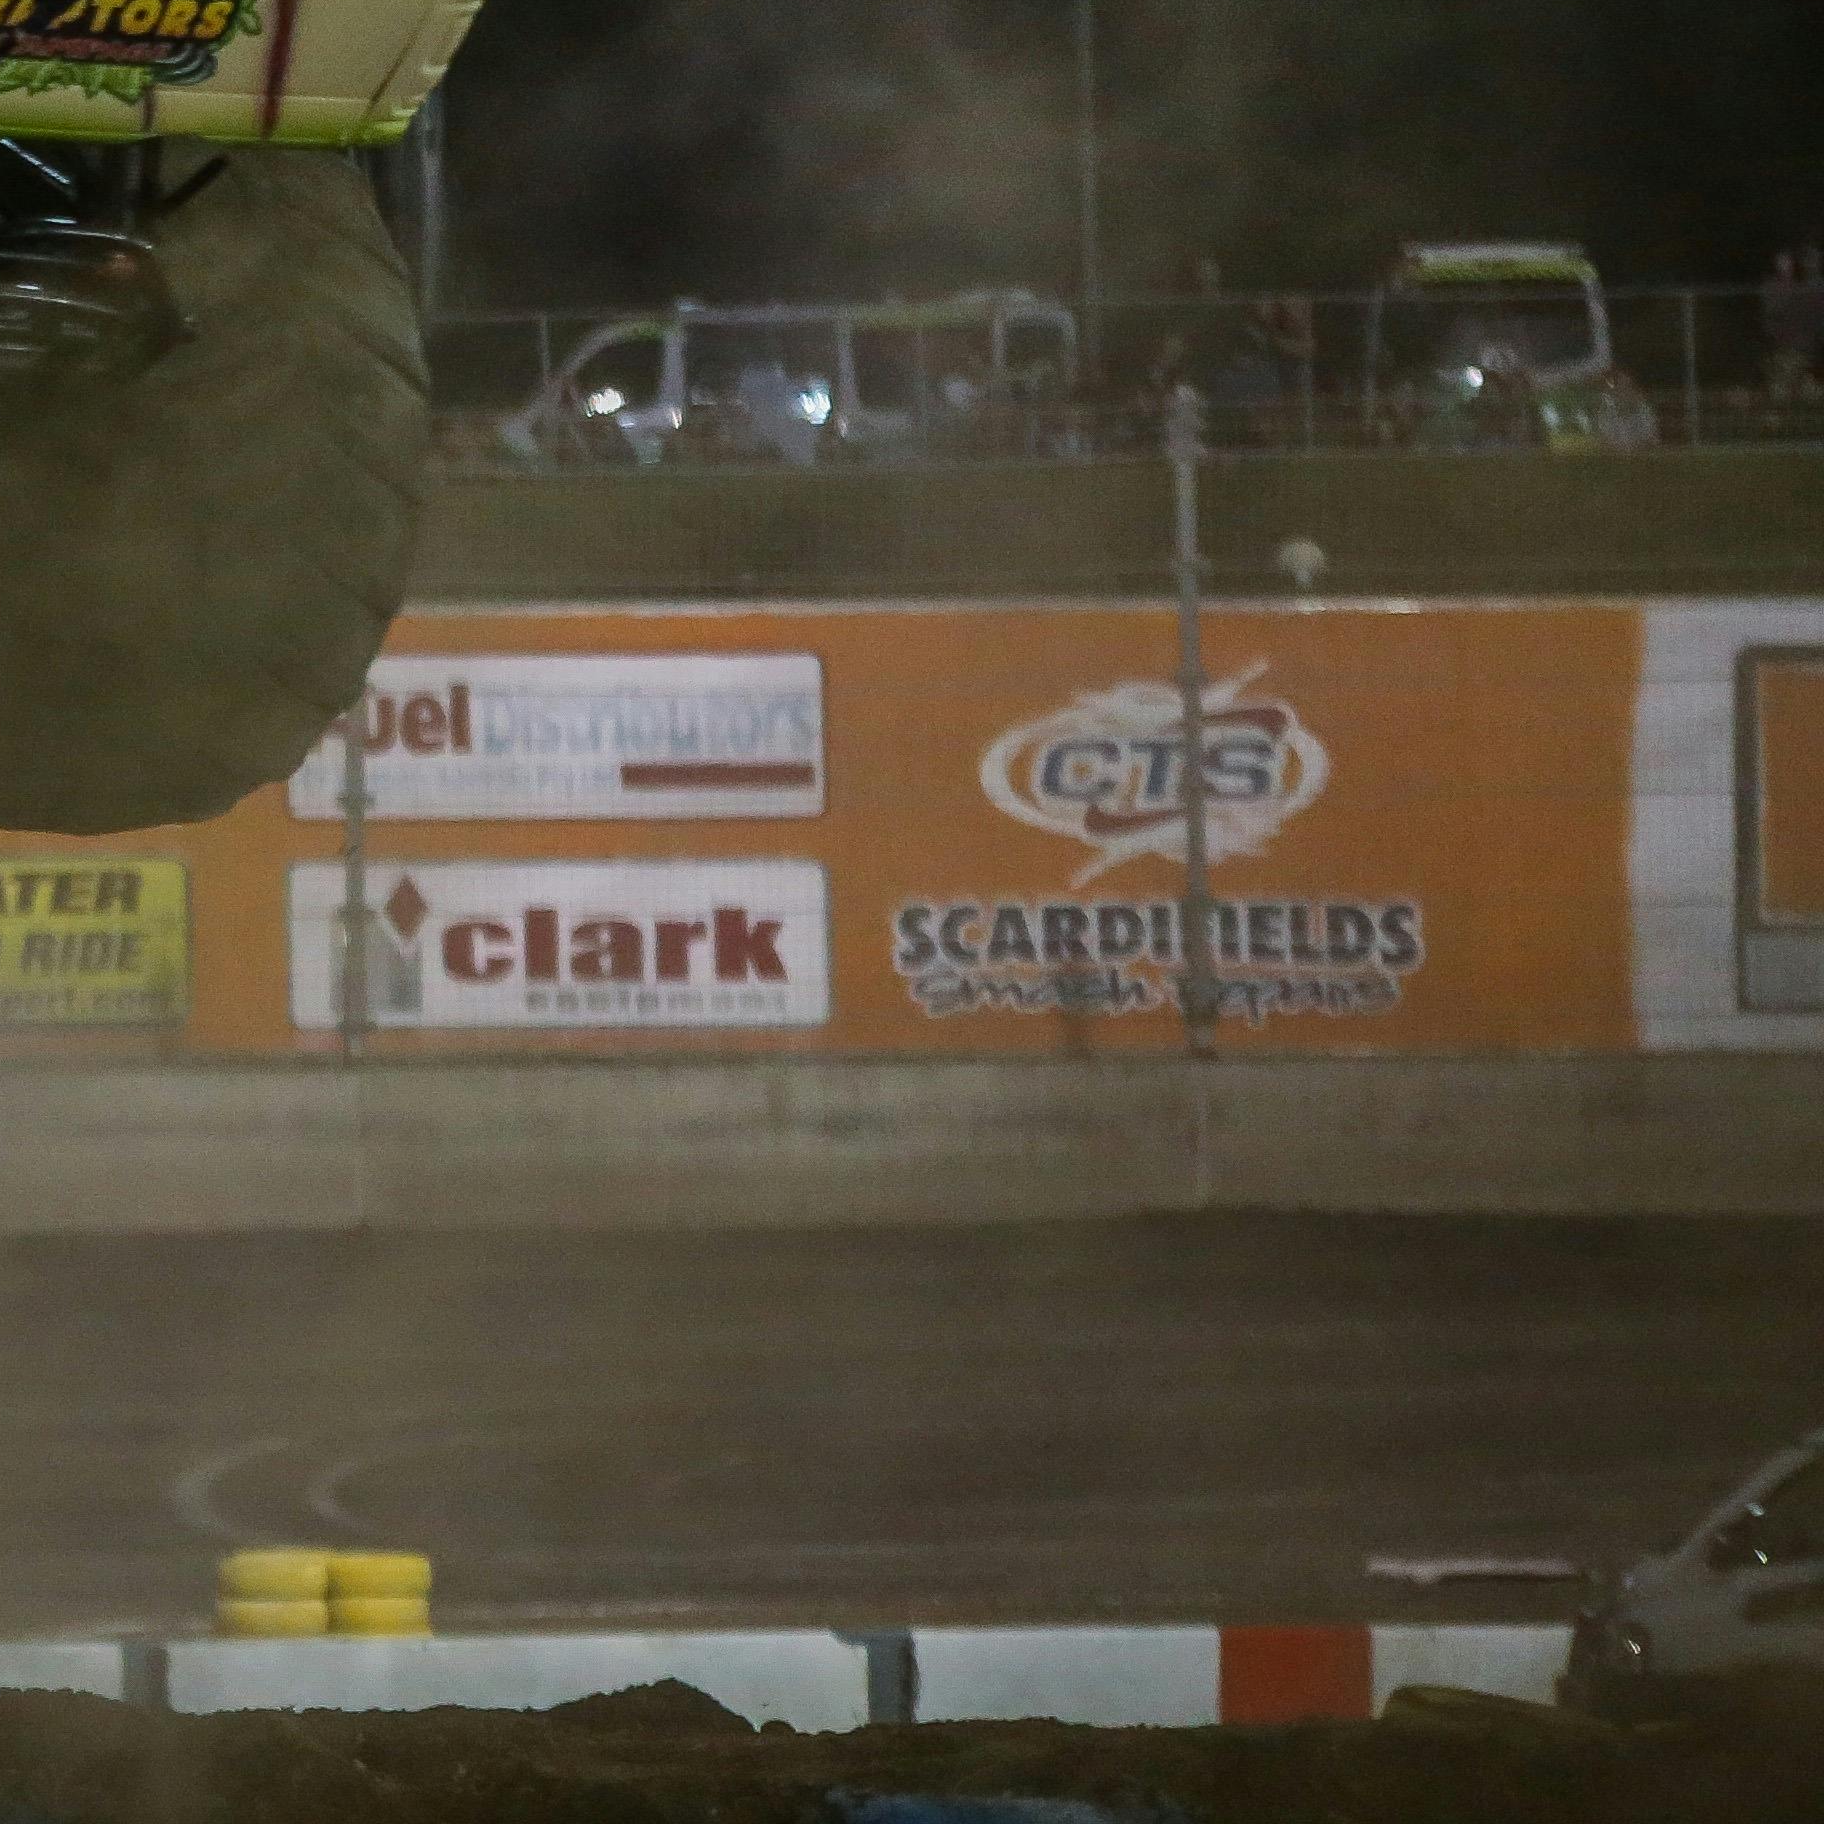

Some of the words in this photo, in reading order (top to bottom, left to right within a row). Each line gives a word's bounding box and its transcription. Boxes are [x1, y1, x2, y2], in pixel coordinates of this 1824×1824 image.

[22, 930, 148, 976] RIDE
[441, 908, 790, 984] clark
[897, 903, 1422, 969] SCARDIIELDS
